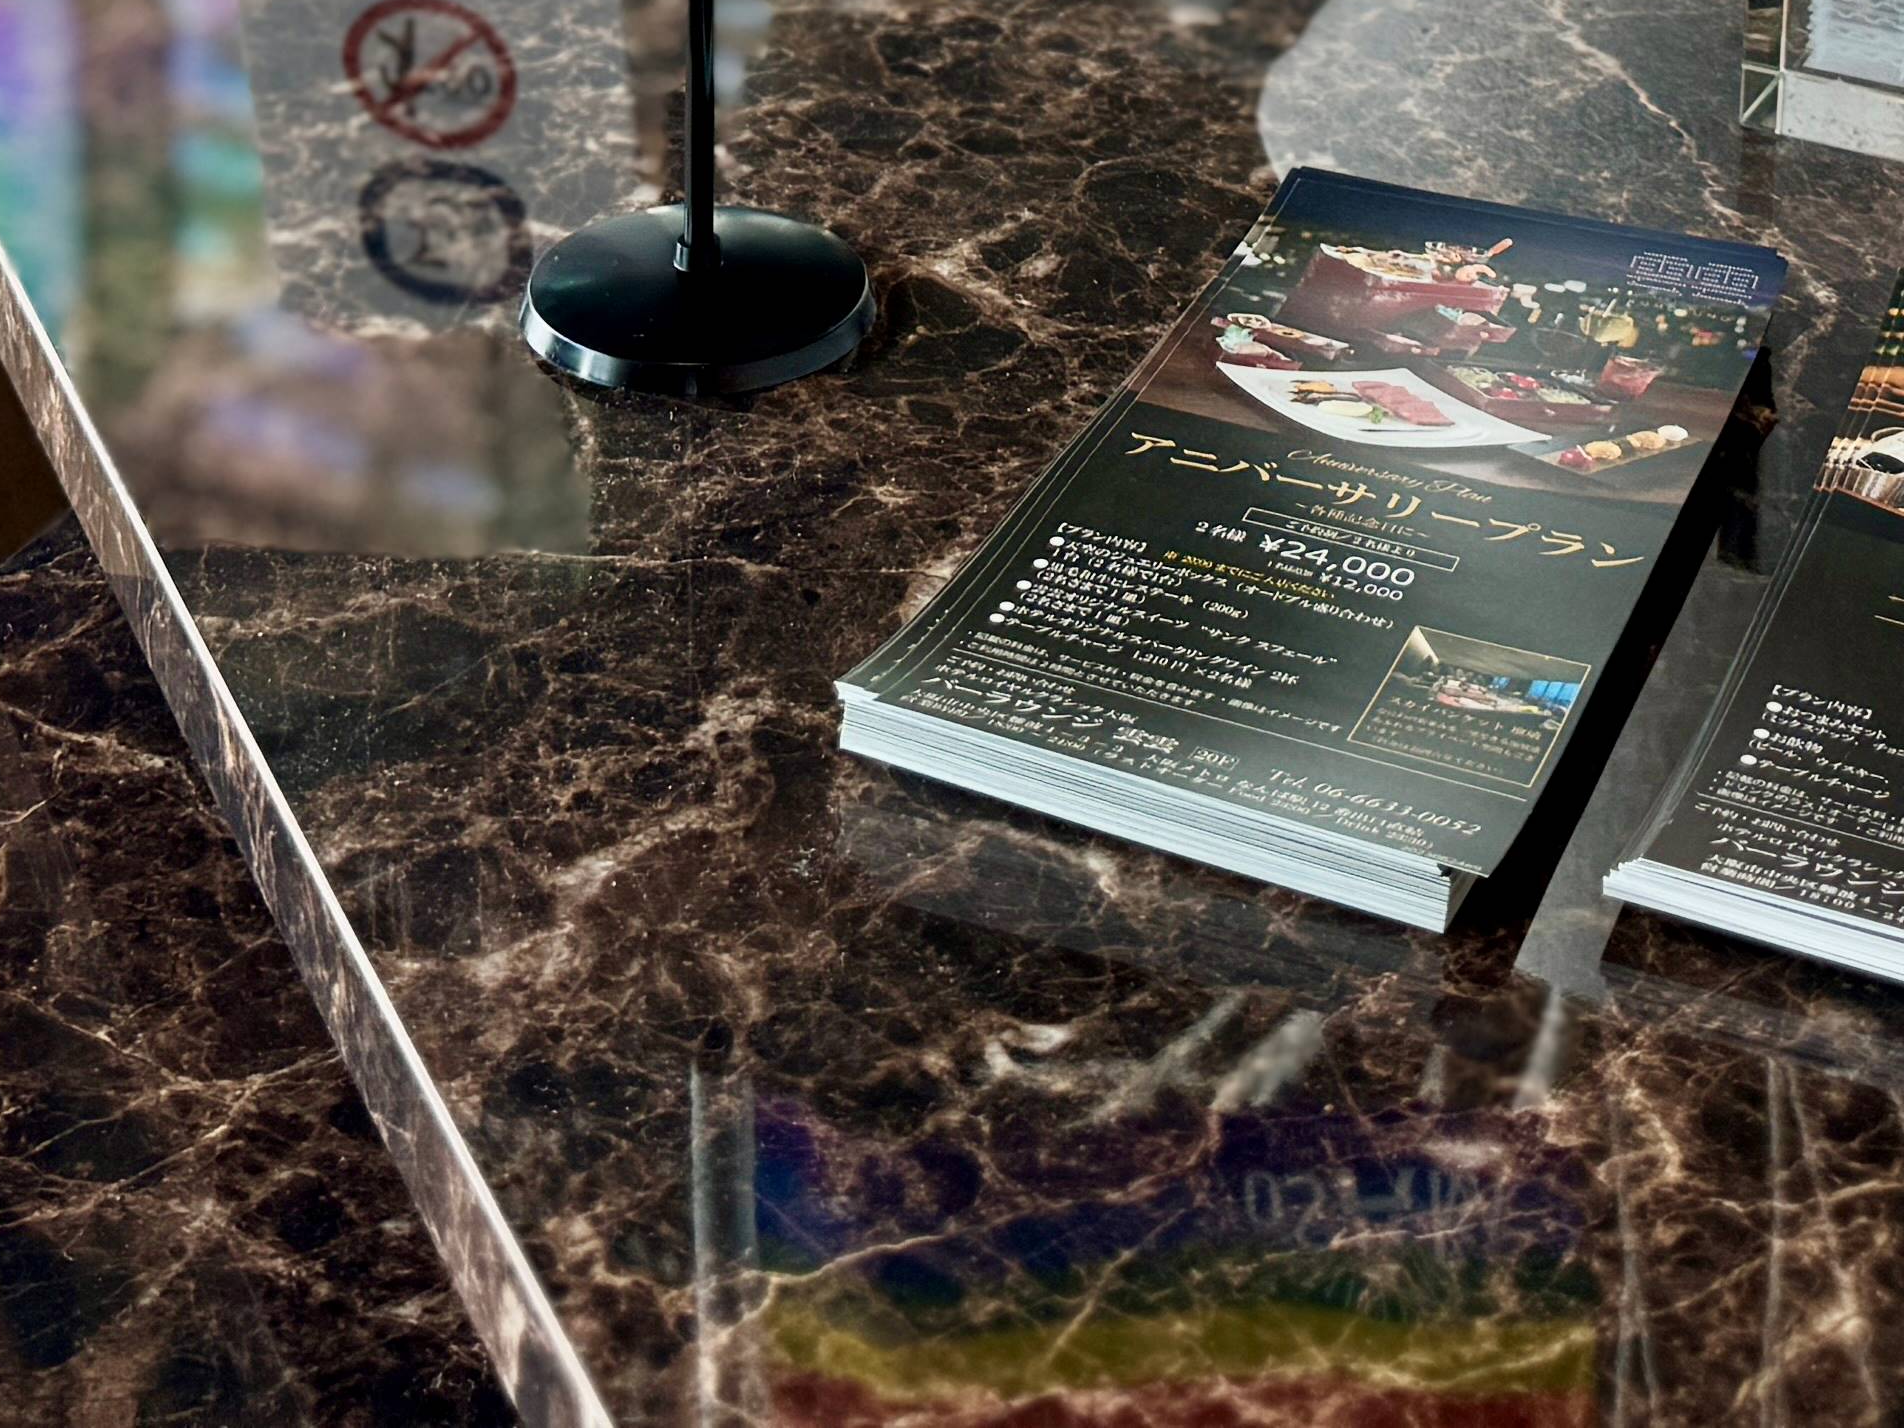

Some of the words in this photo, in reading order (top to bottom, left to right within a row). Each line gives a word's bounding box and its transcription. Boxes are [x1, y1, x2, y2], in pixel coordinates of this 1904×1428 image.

[1125, 430, 1646, 569] アニバーサリープラン
[1251, 532, 1421, 593] ¥24,000
[1314, 569, 1407, 604] ¥12,000
[919, 676, 1104, 730] バーラウンジ
